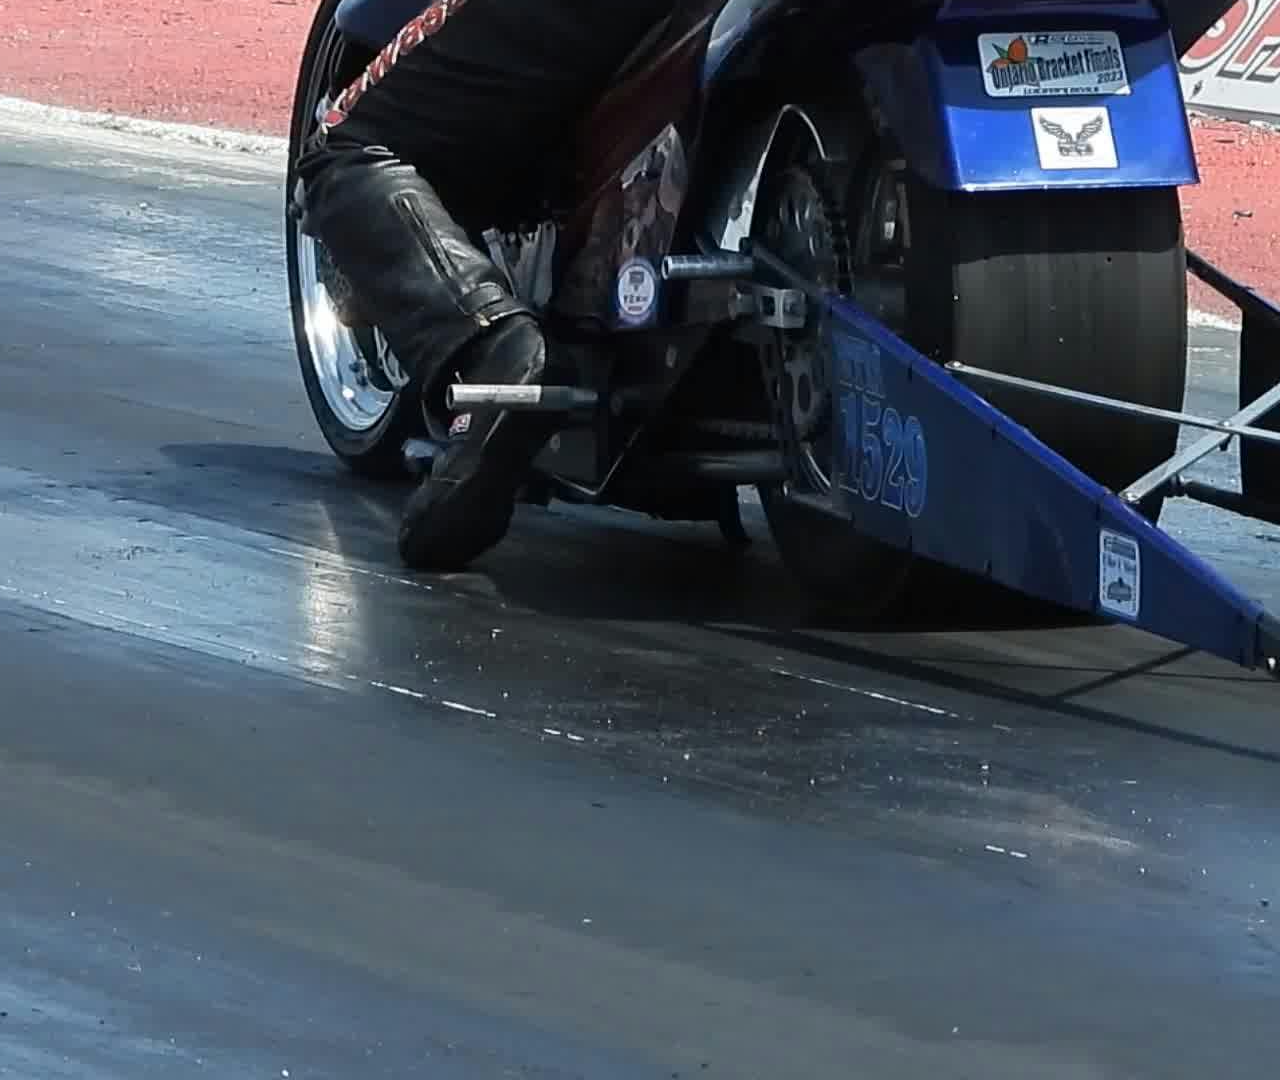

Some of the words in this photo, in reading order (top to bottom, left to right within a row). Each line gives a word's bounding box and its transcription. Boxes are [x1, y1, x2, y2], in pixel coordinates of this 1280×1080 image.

[991, 62, 1038, 93] Ontario
[1037, 51, 1086, 81] Bracket
[1085, 45, 1122, 74] Finals
